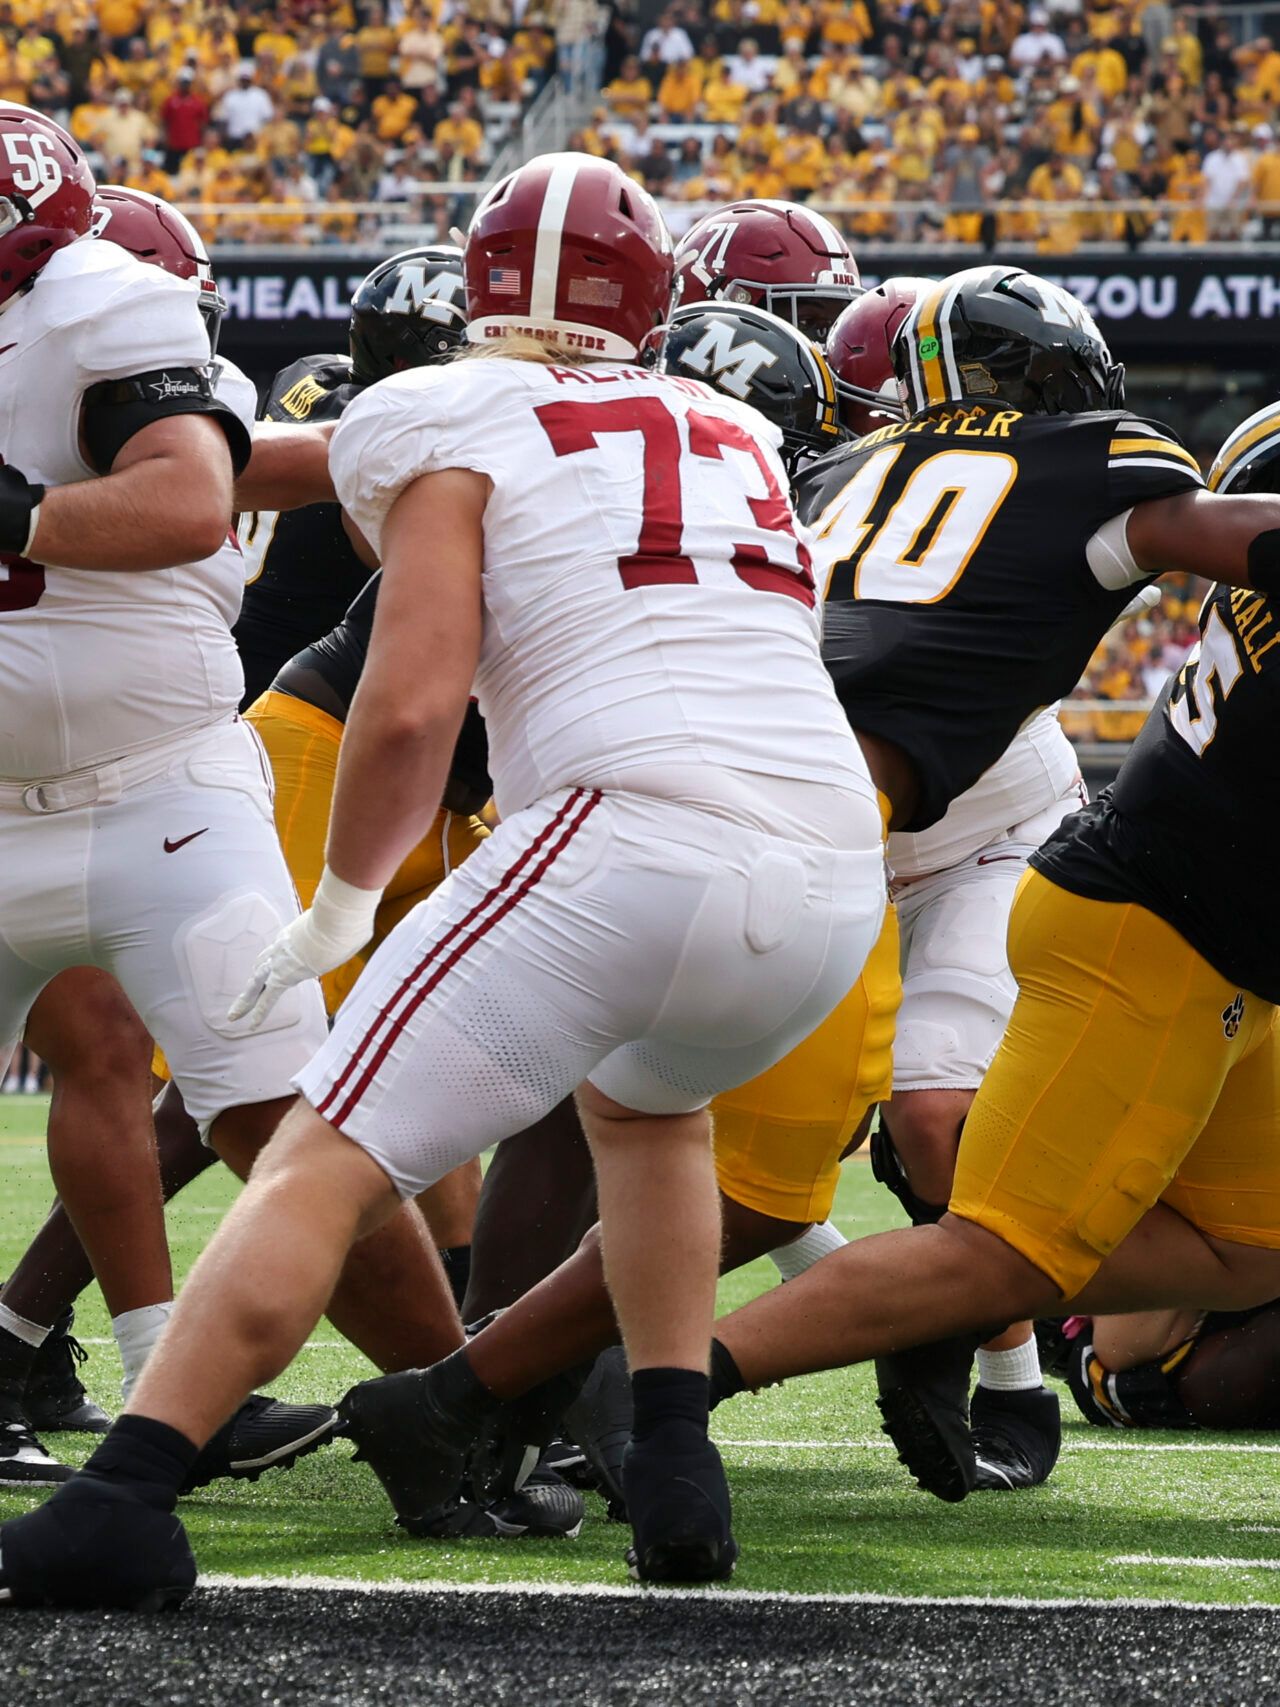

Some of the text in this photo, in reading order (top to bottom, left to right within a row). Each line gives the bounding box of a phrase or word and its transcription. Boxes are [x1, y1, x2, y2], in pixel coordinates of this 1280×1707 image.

[2, 133, 62, 191] 56
[695, 223, 739, 269] 71
[218, 276, 362, 319] HEAL
[1042, 273, 1177, 320] ZOU
[565, 332, 606, 351] TIDE
[678, 319, 780, 401] M
[920, 341, 937, 355] C2P
[532, 396, 816, 611] 73
[808, 442, 1019, 605] 40
[1169, 601, 1244, 759] 5
